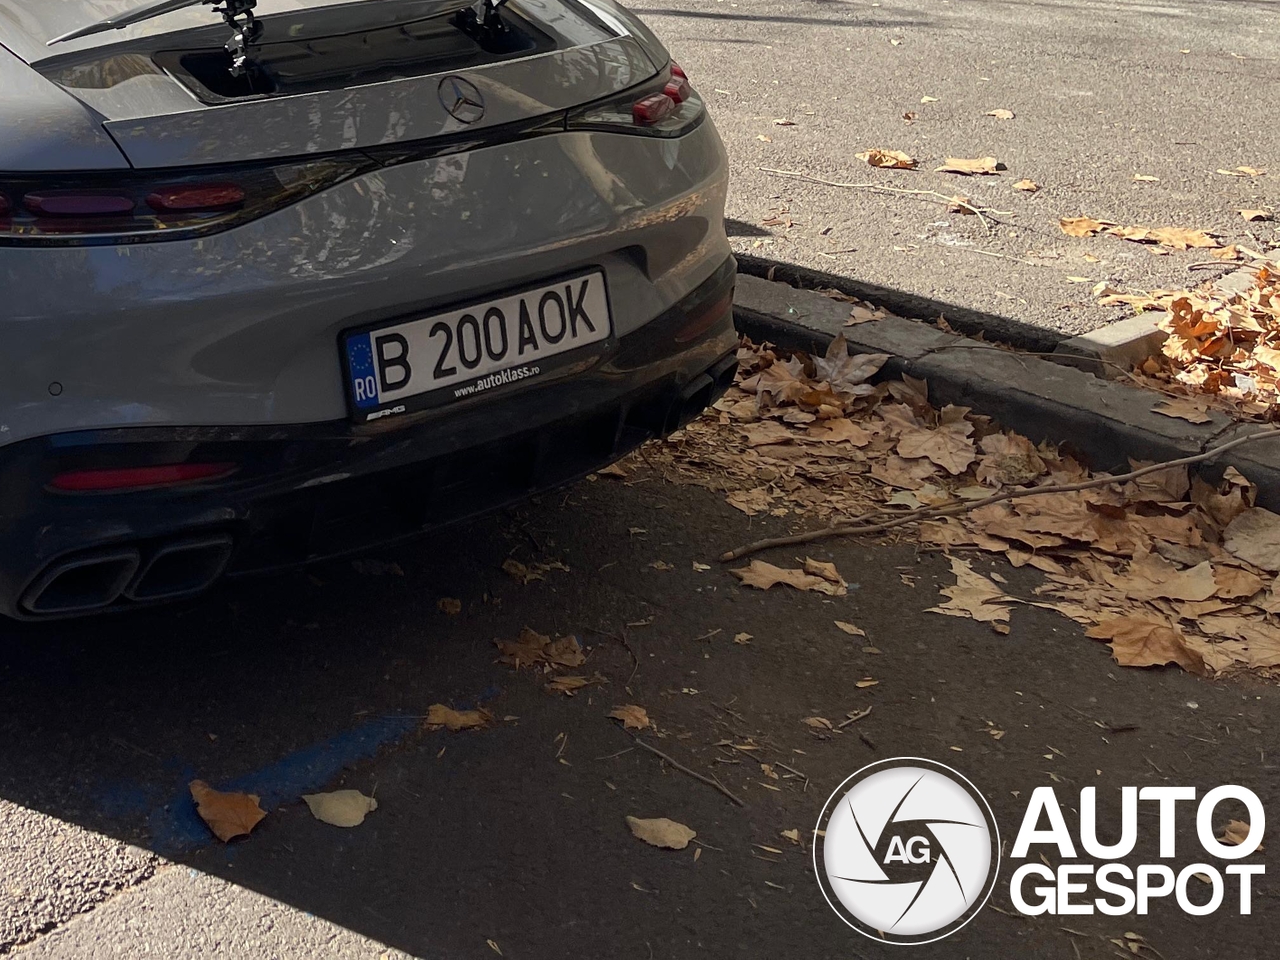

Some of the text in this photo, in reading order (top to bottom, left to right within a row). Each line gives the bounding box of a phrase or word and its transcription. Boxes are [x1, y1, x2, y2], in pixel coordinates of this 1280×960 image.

[375, 279, 596, 393] B 200 AOK
[354, 376, 377, 401] RO
[454, 366, 540, 397] www.autoklass.ro
